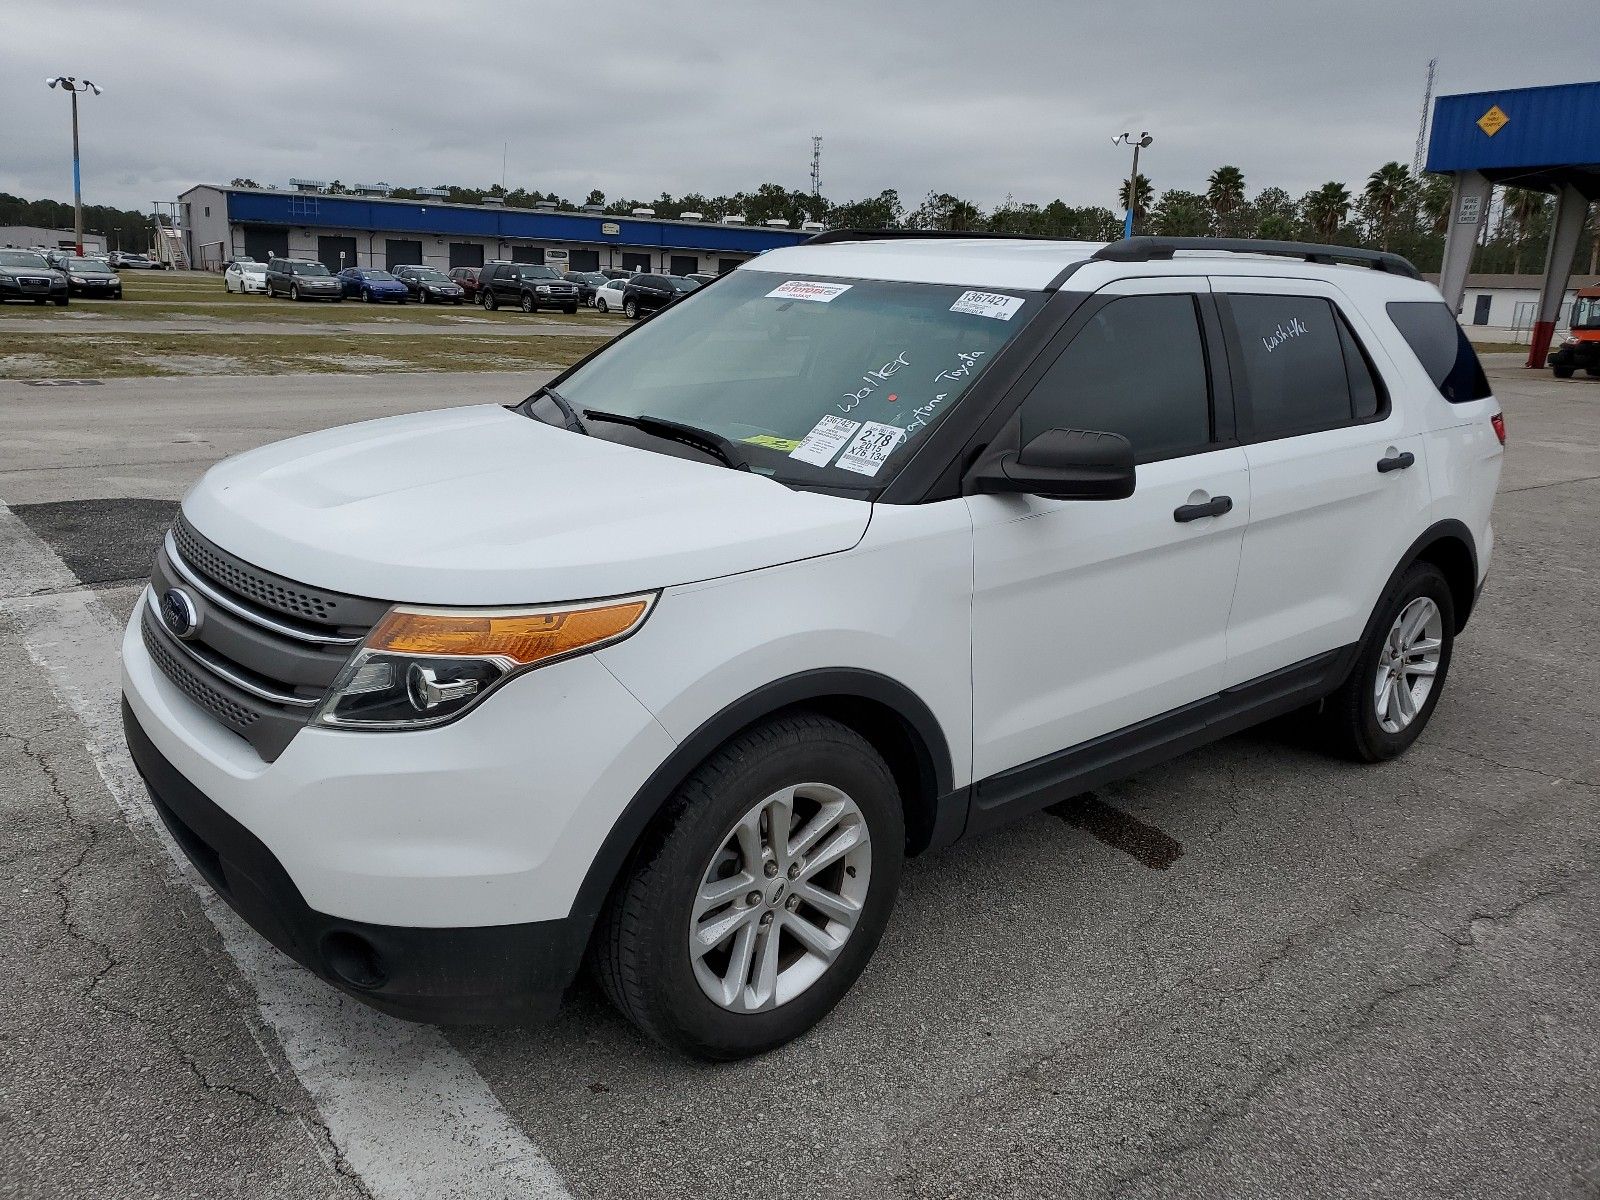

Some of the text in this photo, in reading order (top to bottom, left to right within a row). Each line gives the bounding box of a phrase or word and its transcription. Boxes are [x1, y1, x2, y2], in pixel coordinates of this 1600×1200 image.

[962, 292, 1010, 307] 1367421
[934, 350, 986, 383] Toyota
[823, 415, 856, 429] 1367421
[857, 442, 883, 453] 2015
